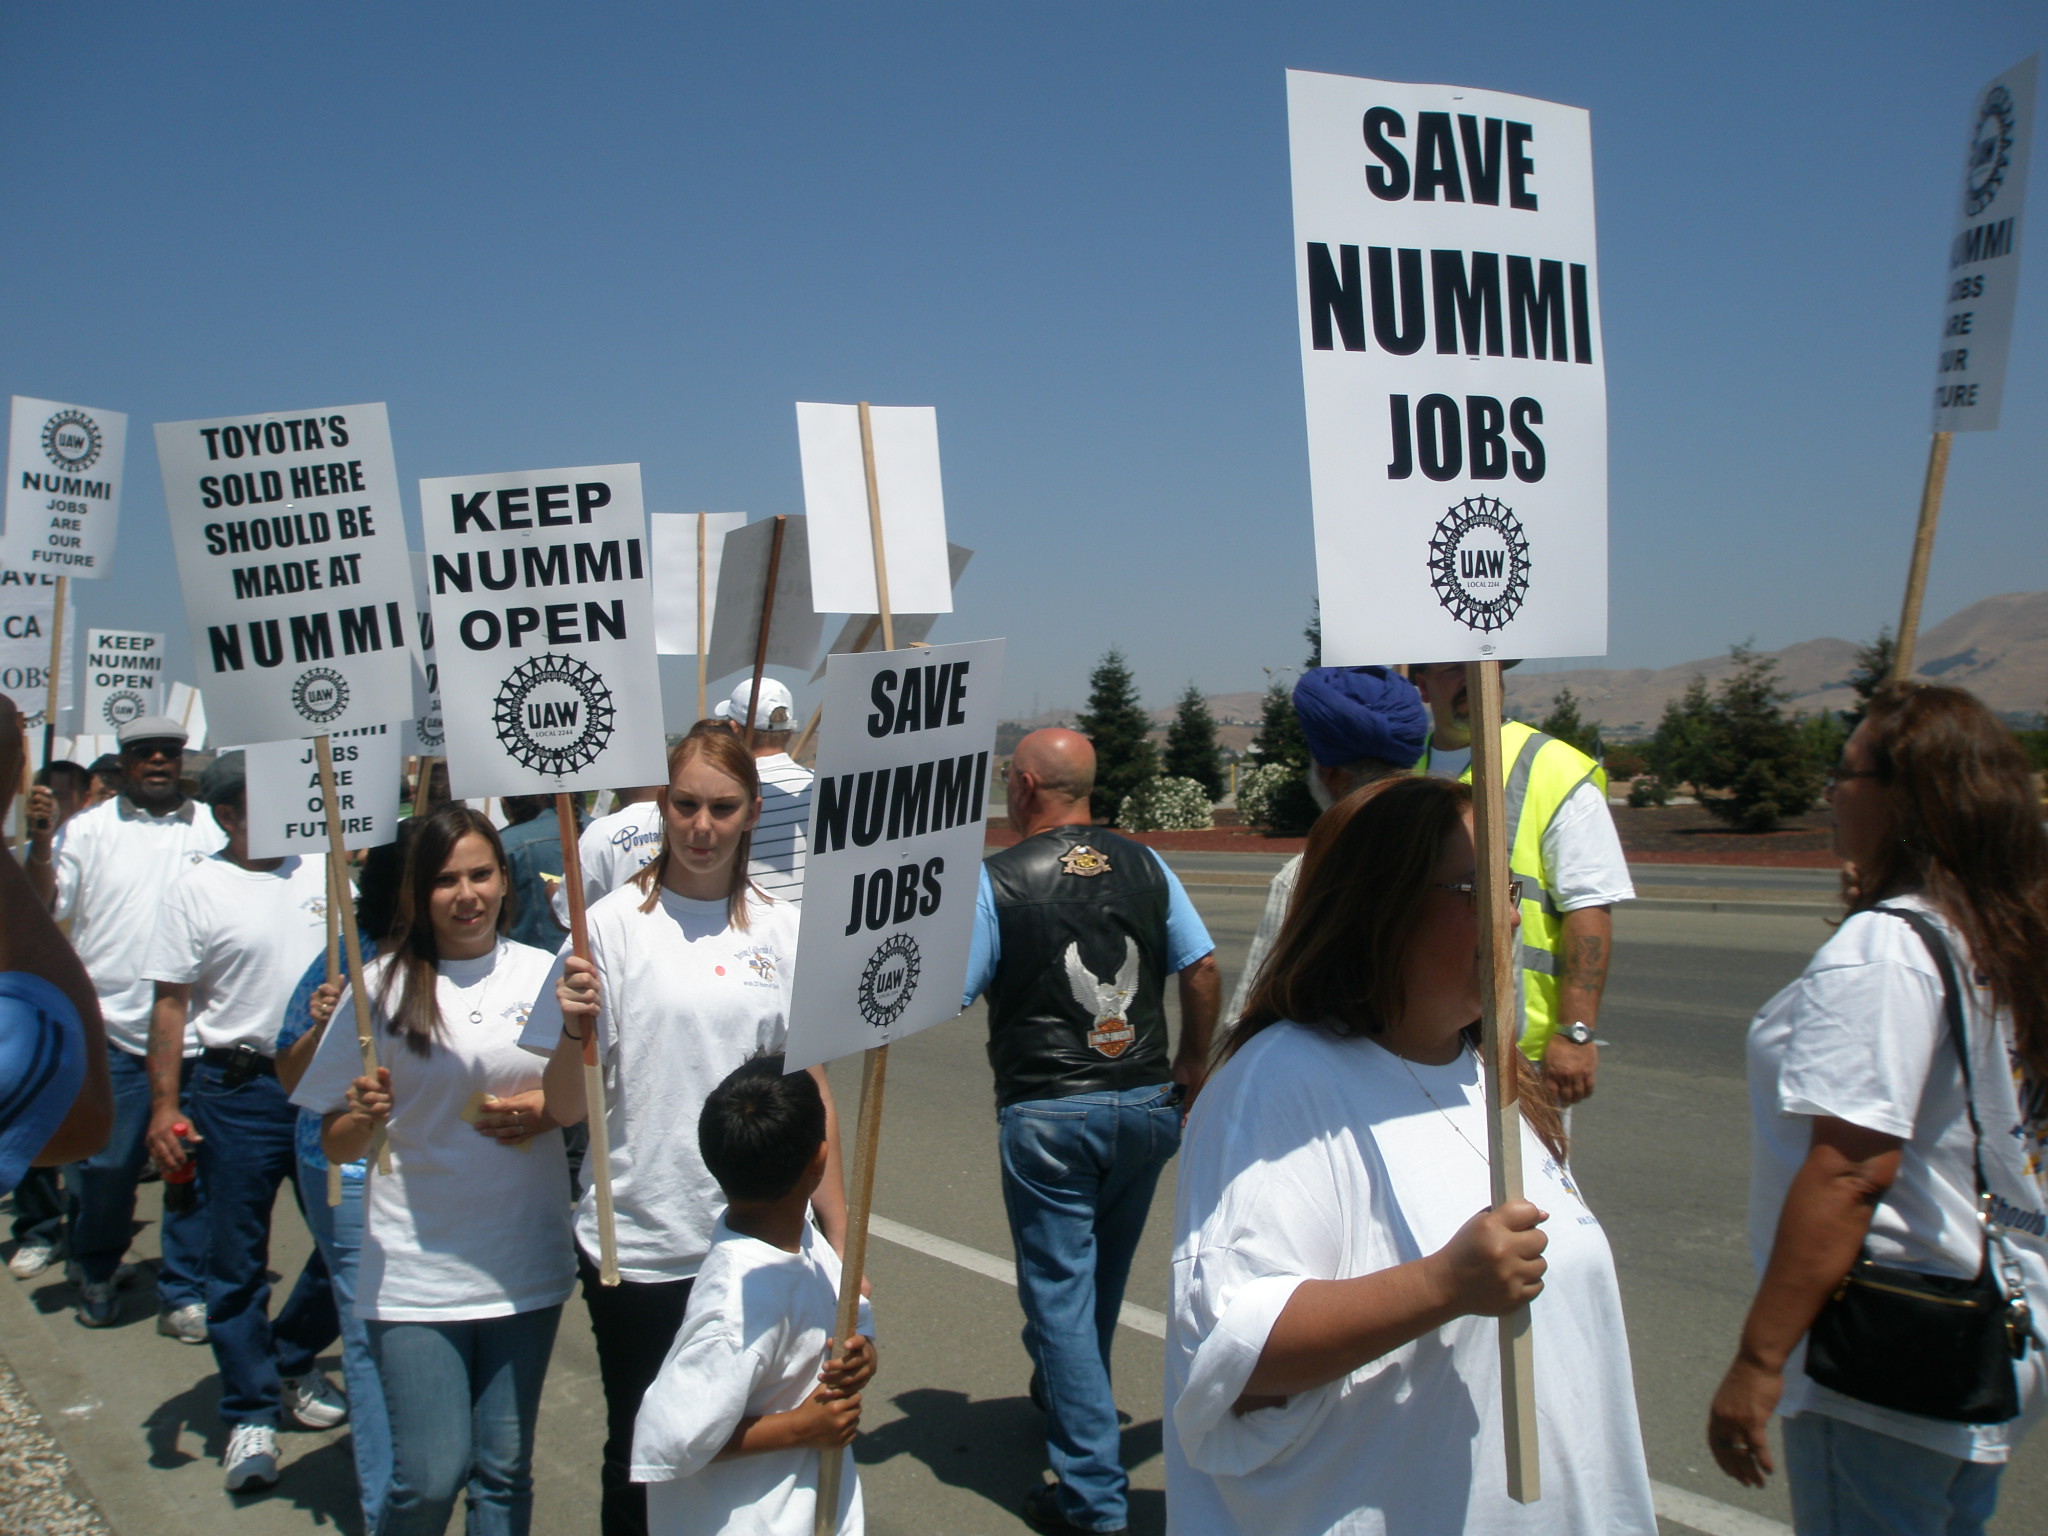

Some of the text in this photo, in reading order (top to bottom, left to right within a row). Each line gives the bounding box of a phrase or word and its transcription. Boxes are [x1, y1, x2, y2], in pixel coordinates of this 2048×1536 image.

[1363, 107, 1537, 211] SAVE
[1307, 242, 1592, 364] NUMMI
[59, 433, 85, 450] UAW
[200, 414, 349, 461] TOYOTA'S
[1388, 394, 1545, 483] JOBS
[23, 471, 111, 501] NUMMI
[200, 461, 365, 508] SOLD HERE
[47, 500, 87, 514] JOBS
[451, 483, 611, 533] KEEP
[51, 517, 81, 531] ARE
[205, 506, 375, 555] SHOULD BE
[49, 534, 81, 548] OUR
[32, 550, 94, 567] FUTURE
[433, 539, 643, 594] NUMMI
[1456, 519, 1467, 532] AND
[1505, 589, 1512, 598] OF
[1461, 550, 1504, 578] UAW
[232, 553, 361, 599] MADE AT
[3, 615, 41, 639] CA
[208, 602, 404, 673] NUMMI
[460, 600, 626, 651] OPEN
[99, 636, 155, 651] KEEP
[88, 654, 161, 671] NUMMI
[2, 667, 51, 690] OBS
[96, 674, 153, 689] OPEN
[308, 688, 333, 703] UAW
[868, 661, 969, 738] SAVE
[528, 701, 578, 729] UAW
[300, 745, 359, 764] JBS
[307, 795, 355, 813] OR
[813, 751, 988, 855] NUMMI
[845, 857, 944, 936] JOBS
[877, 967, 905, 994] UAW
